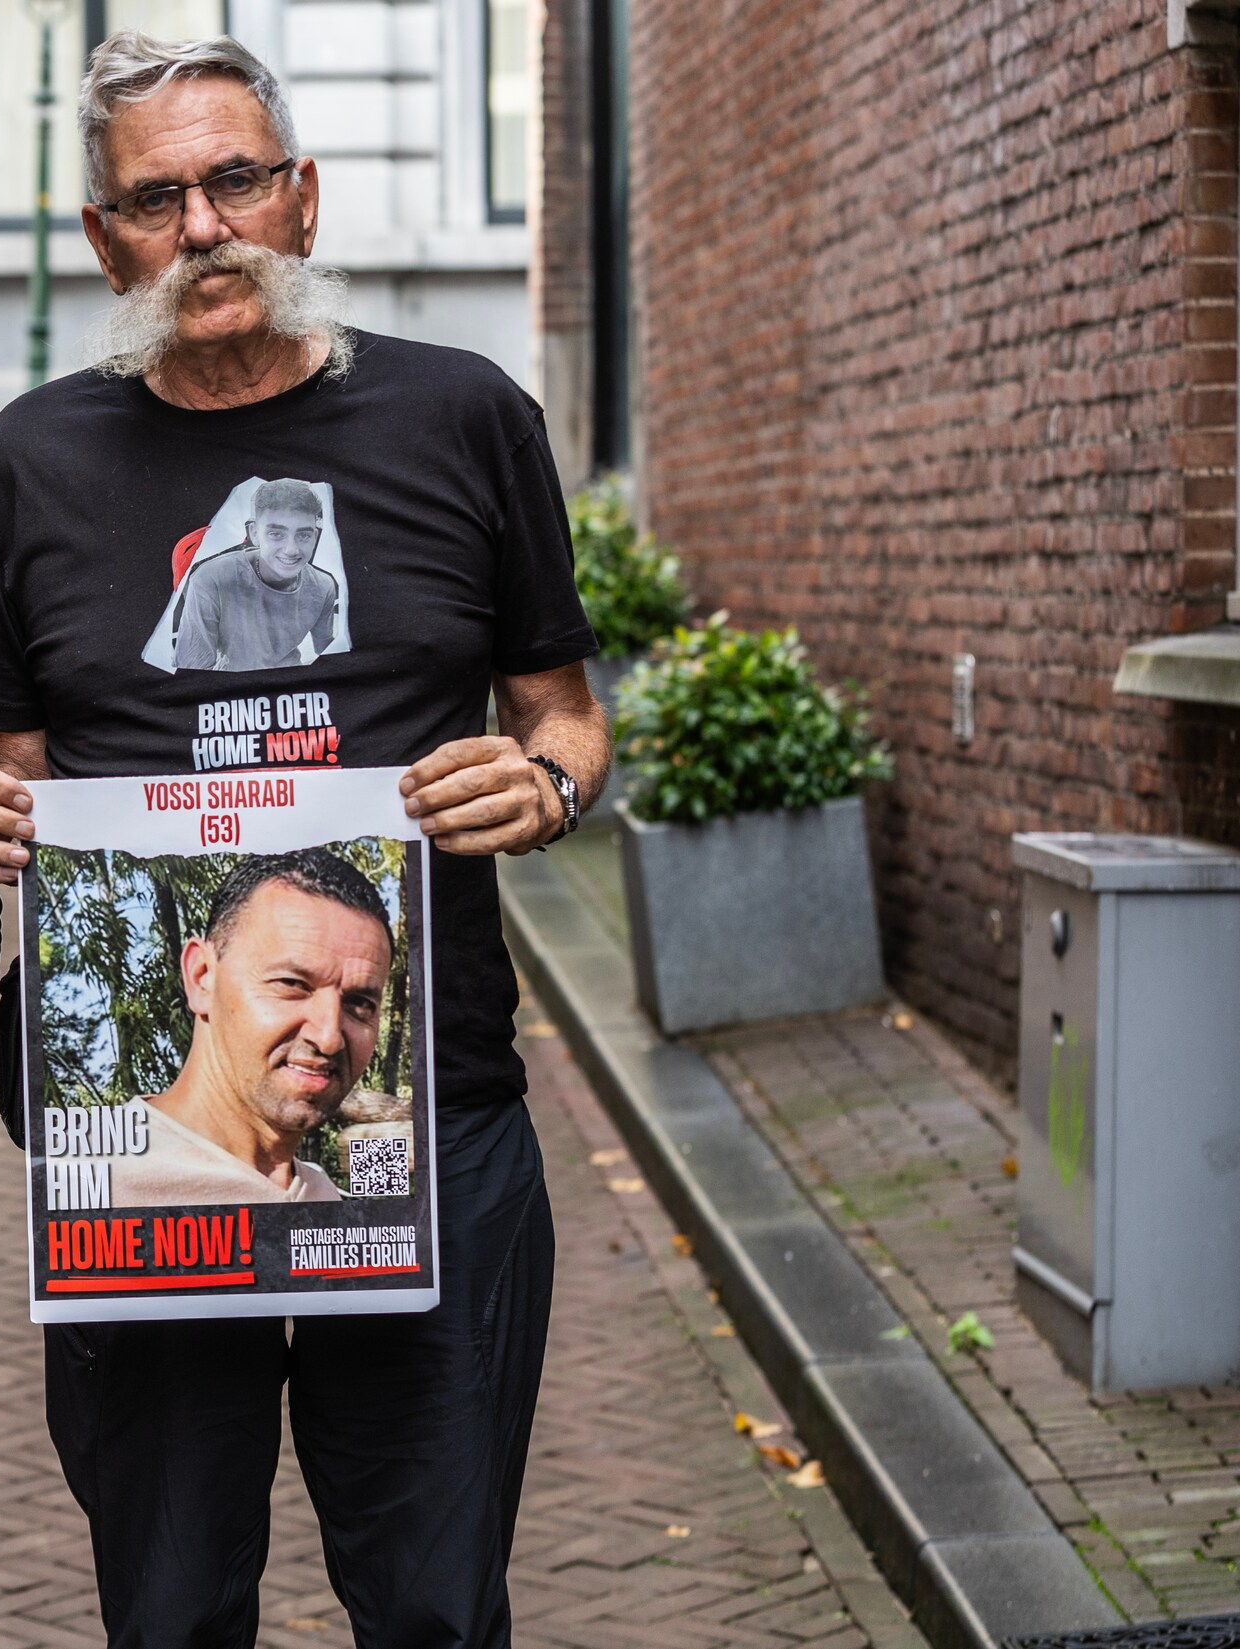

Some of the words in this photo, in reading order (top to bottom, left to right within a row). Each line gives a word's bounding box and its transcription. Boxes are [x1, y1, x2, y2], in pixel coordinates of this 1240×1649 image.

[198, 697, 270, 734] BRING
[277, 692, 332, 728] OFIR
[192, 734, 261, 771] HOME
[266, 726, 340, 764] NOW!
[144, 781, 201, 811] YOSSI
[207, 778, 295, 809] SHARABI
[200, 813, 241, 846] (53)
[44, 1105, 148, 1156] BRING
[47, 1160, 110, 1211] HIM
[47, 1218, 144, 1271] HOME
[153, 1208, 254, 1267] NOW!
[290, 1227, 344, 1246] HOSTAGES
[346, 1227, 367, 1244] AND
[368, 1225, 415, 1243] MISSING
[290, 1245, 359, 1270] FAMILIES
[363, 1243, 417, 1268] FORUM
